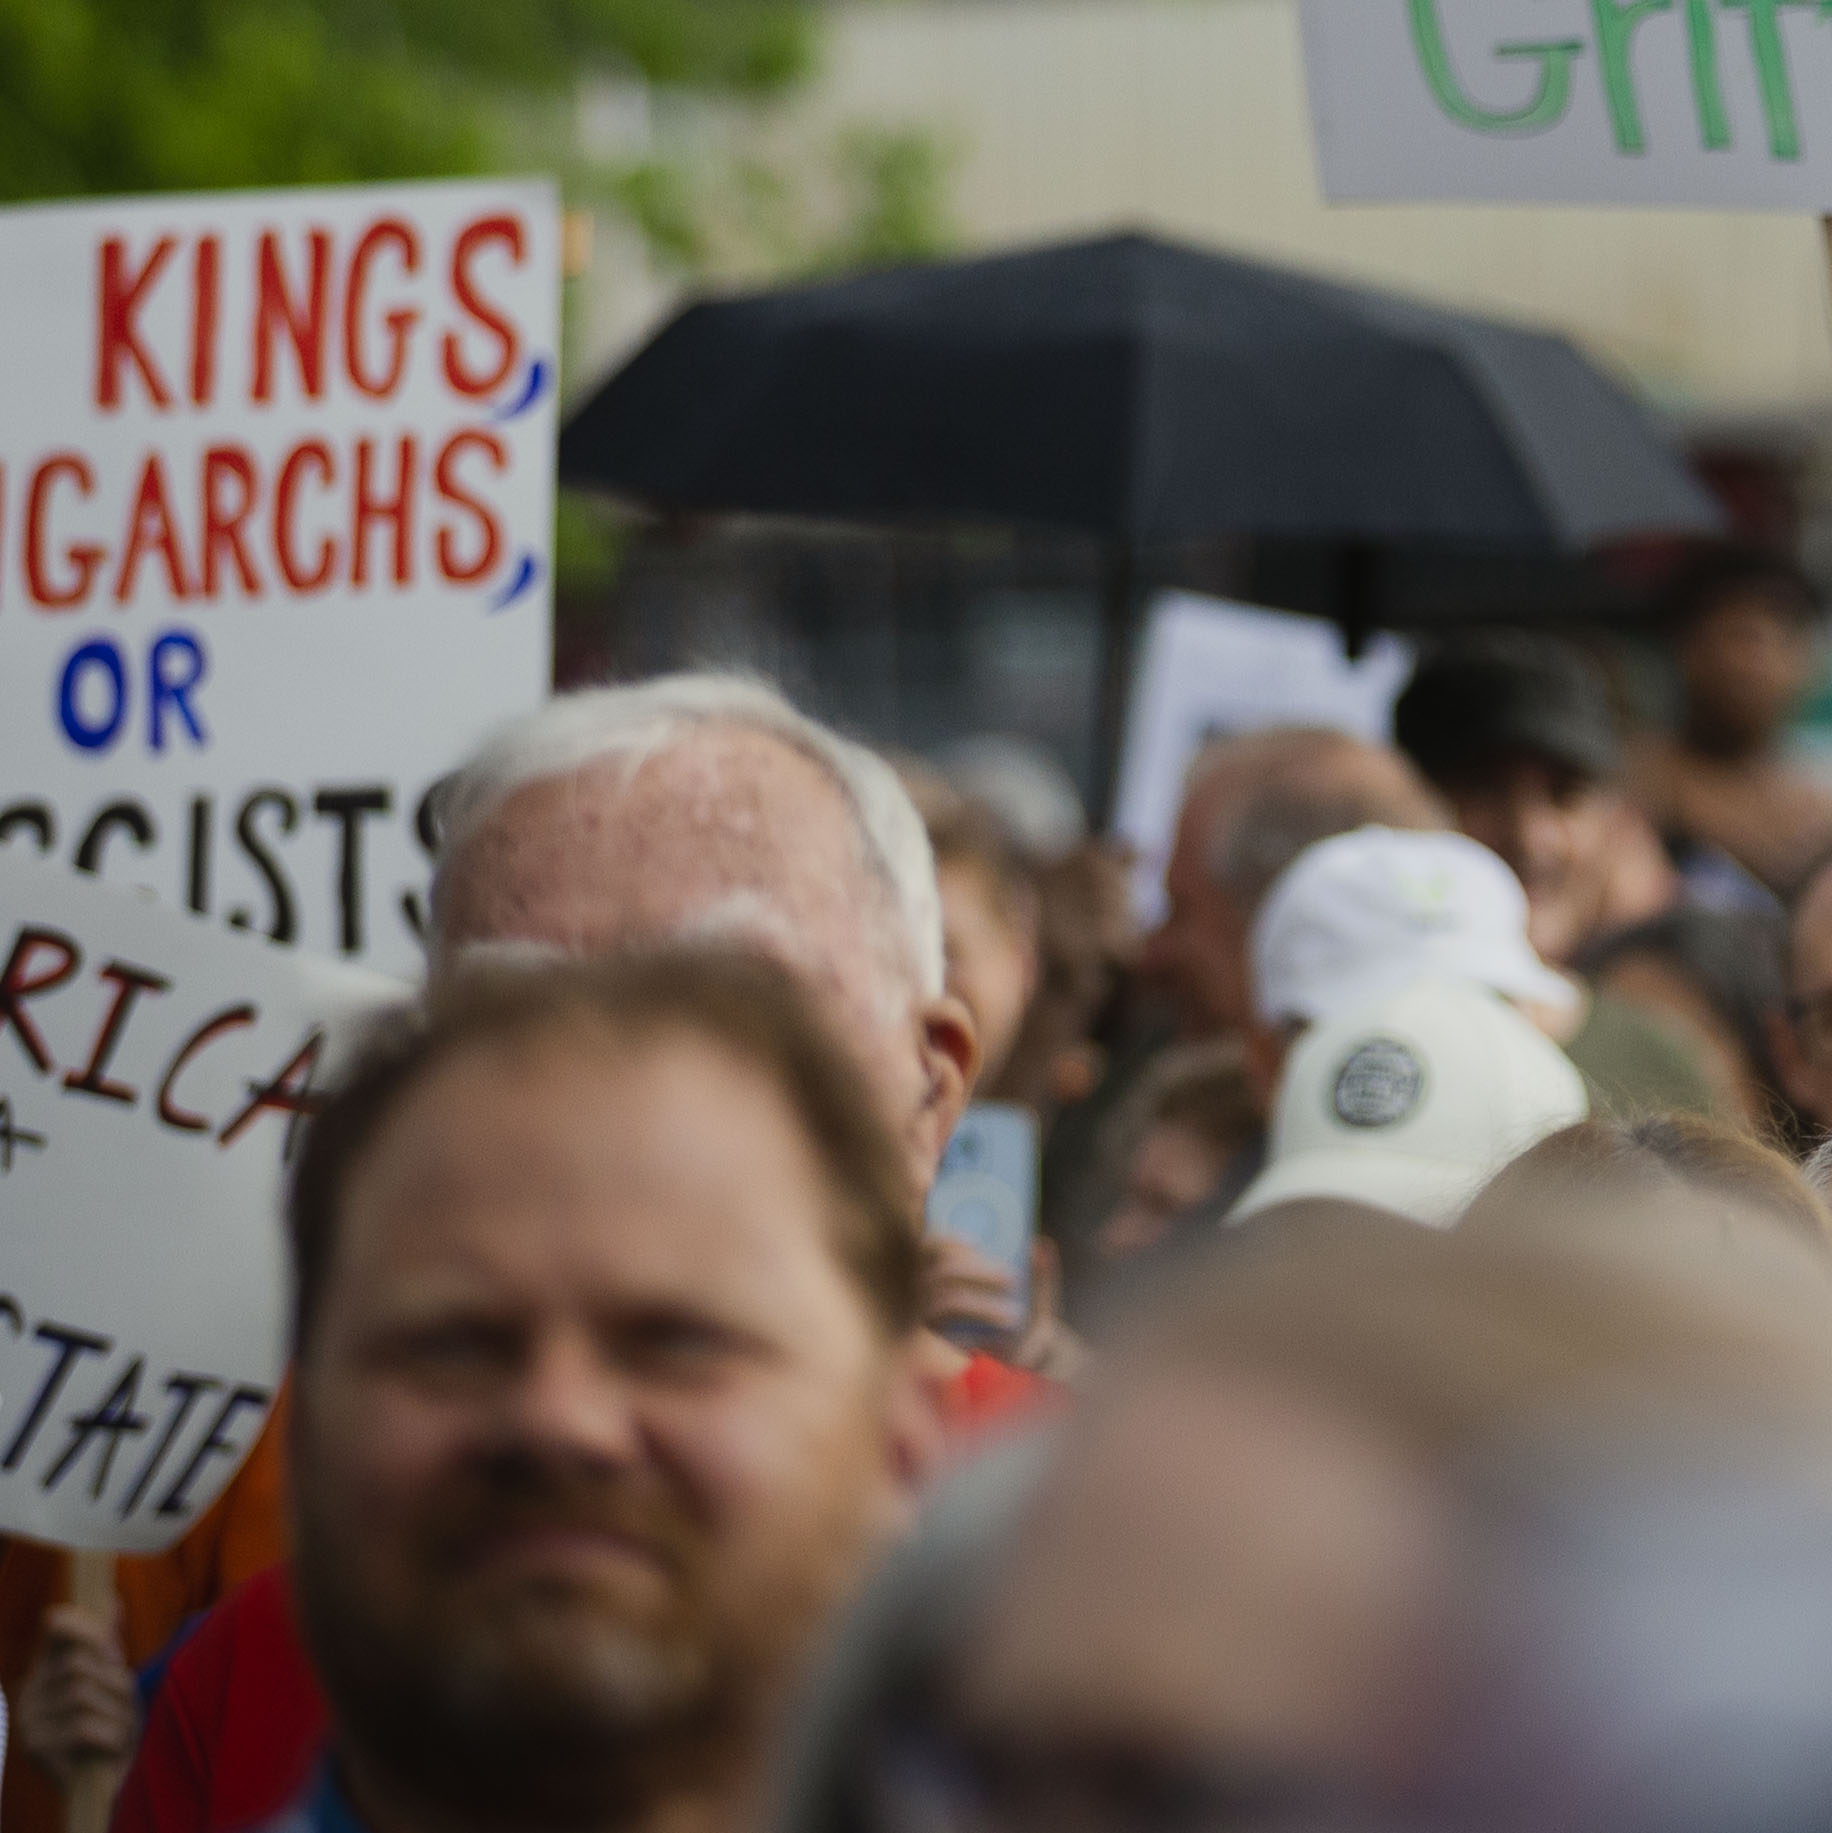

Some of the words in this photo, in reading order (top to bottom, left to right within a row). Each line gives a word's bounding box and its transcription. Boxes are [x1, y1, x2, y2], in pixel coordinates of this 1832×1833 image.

[92, 211, 551, 422] KINGS,
[0, 424, 537, 615] GARCHS,
[56, 624, 209, 756] OR
